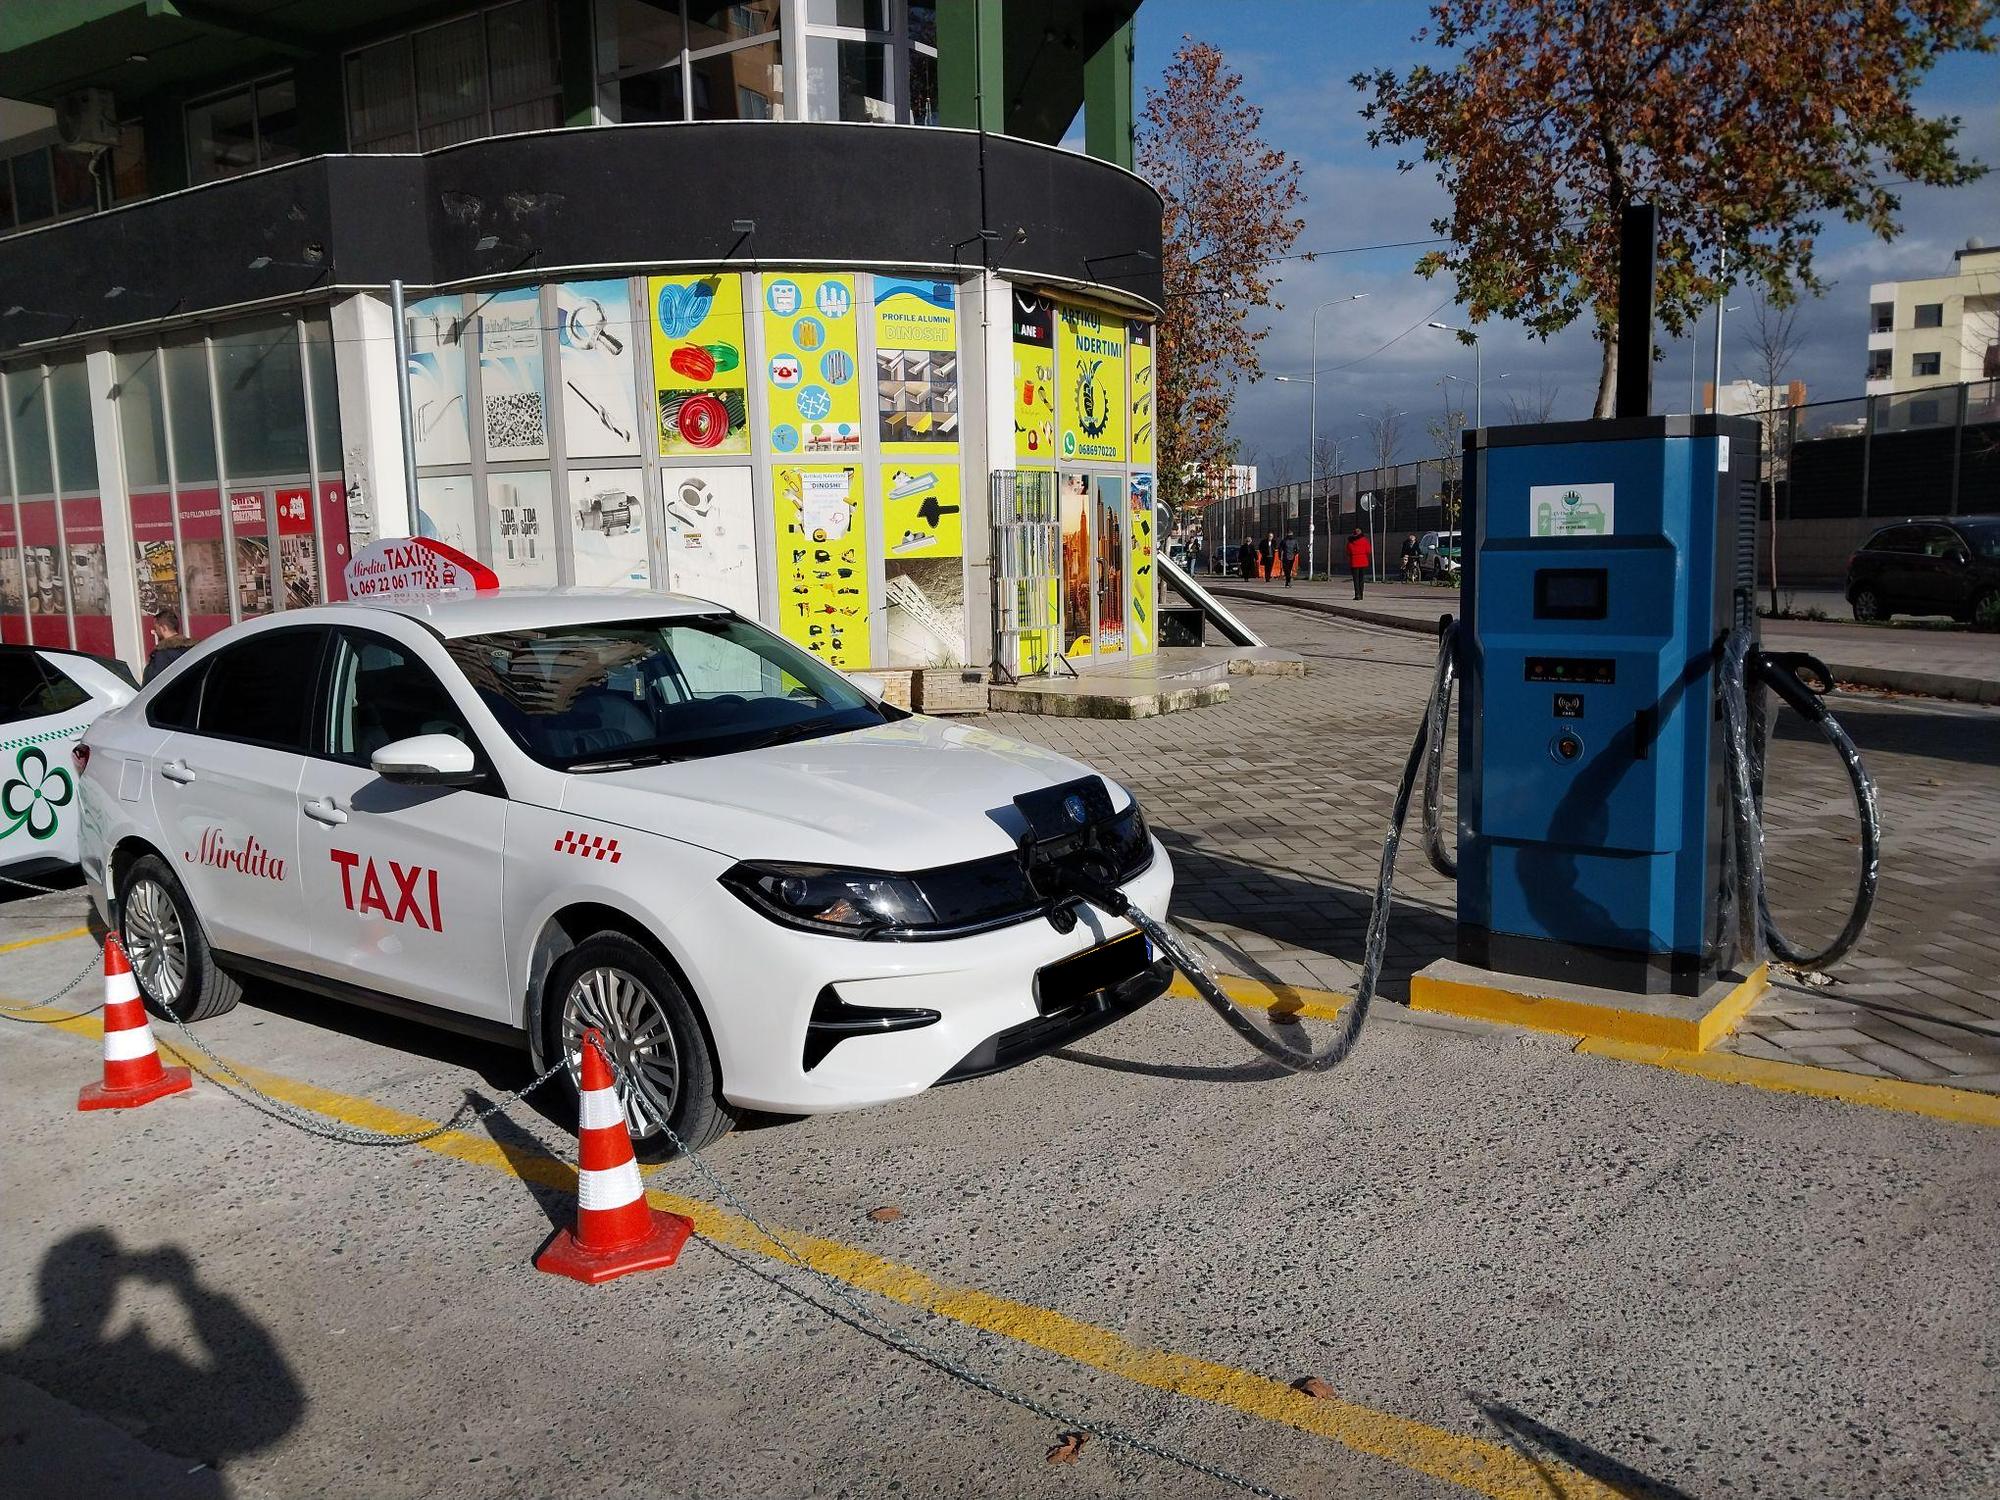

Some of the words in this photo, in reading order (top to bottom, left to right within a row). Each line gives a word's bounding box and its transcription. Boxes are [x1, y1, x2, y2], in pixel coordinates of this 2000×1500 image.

[882, 313, 917, 322] PROFILE
[917, 315, 951, 324] ALUMINI
[1061, 304, 1101, 333] ARTIKUJ
[884, 325, 949, 342] DINOSHI
[1075, 335, 1122, 358] NDERTIMI
[1078, 444, 1117, 457] 0686970220
[811, 482, 841, 490] DINOSHI
[501, 508, 516, 523] TOA
[522, 508, 537, 523] TOA
[349, 558, 386, 579] Mirdita
[384, 544, 422, 571] TAXI
[359, 580, 376, 596] 069
[378, 577, 390, 592] 22
[392, 573, 409, 590] 061
[412, 570, 423, 587] 77
[183, 824, 289, 882] Mirdita
[330, 848, 443, 933] TAXI
